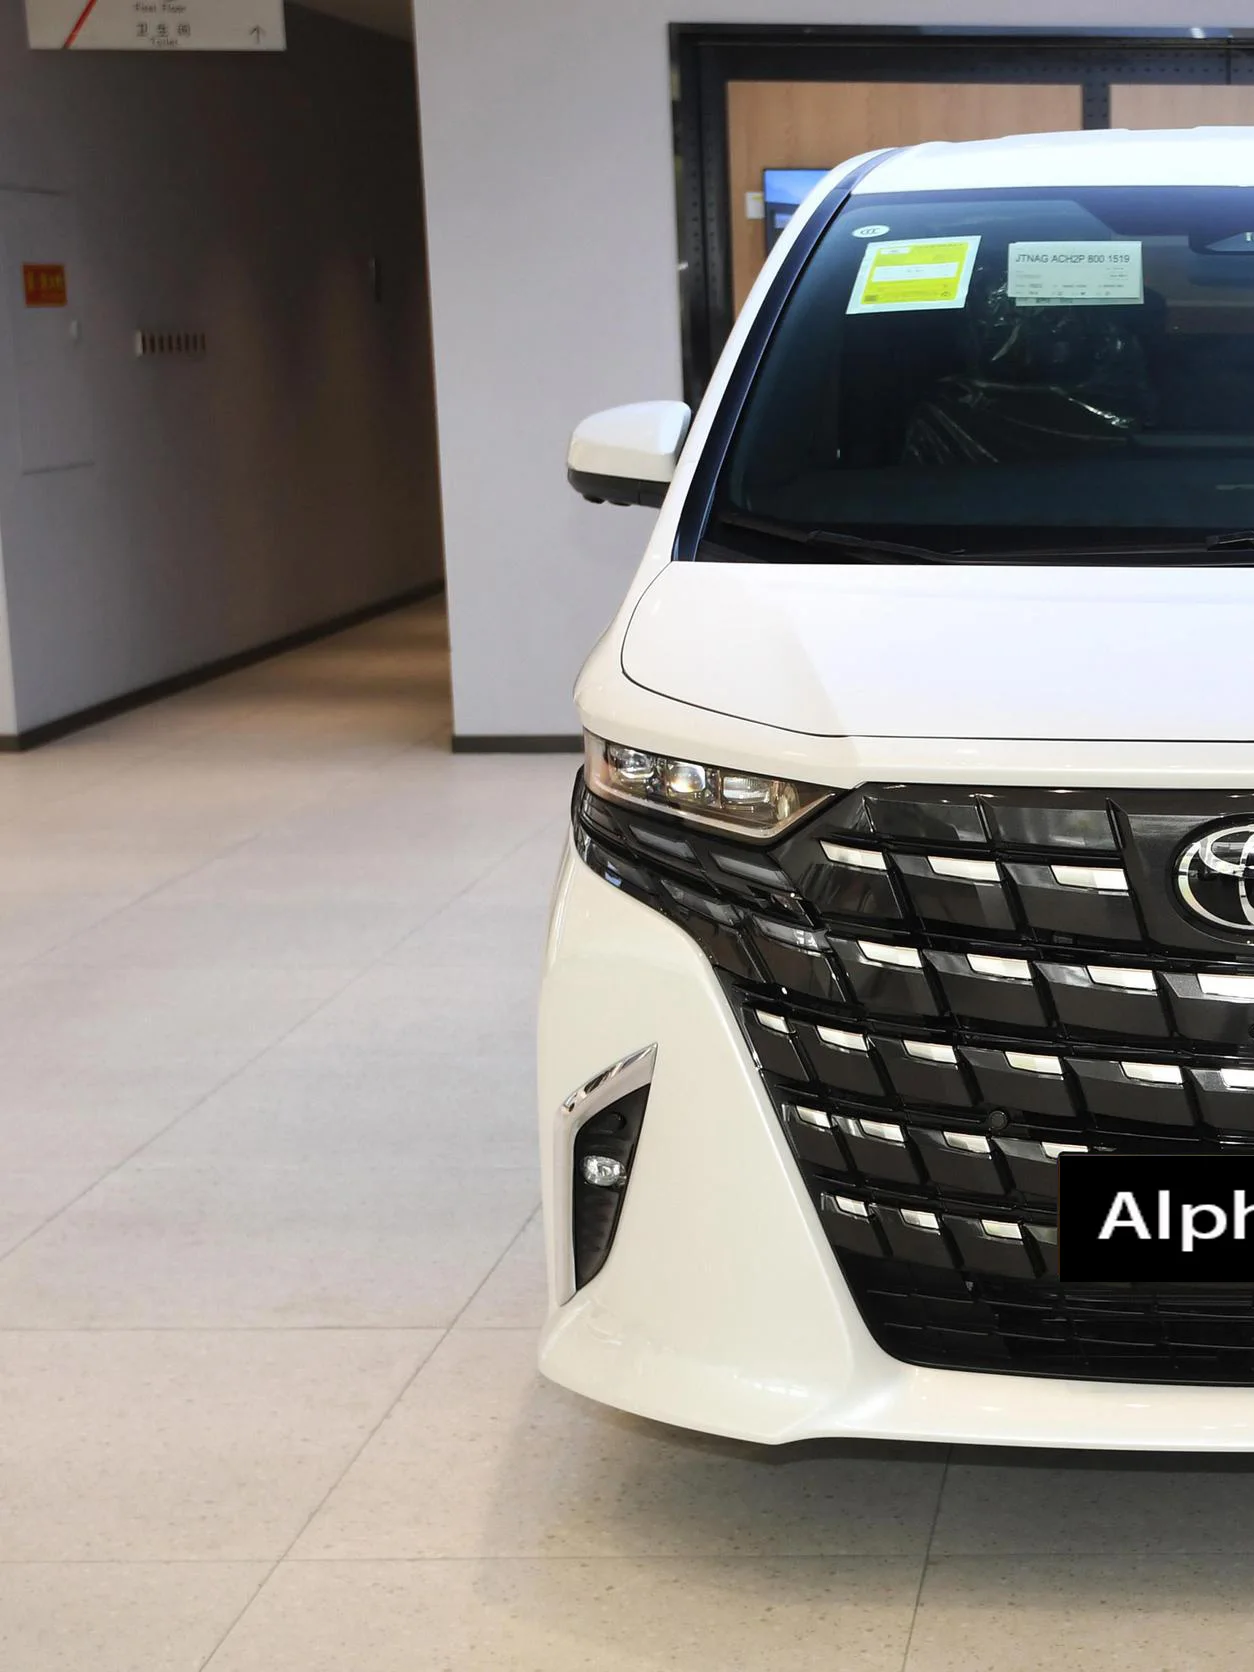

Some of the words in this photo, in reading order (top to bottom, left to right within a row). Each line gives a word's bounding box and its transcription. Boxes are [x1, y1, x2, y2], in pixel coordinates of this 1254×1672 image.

[135, 22, 191, 37] 卫生间
[1015, 254, 1049, 263] JTNAG
[1108, 254, 1130, 263] 1519
